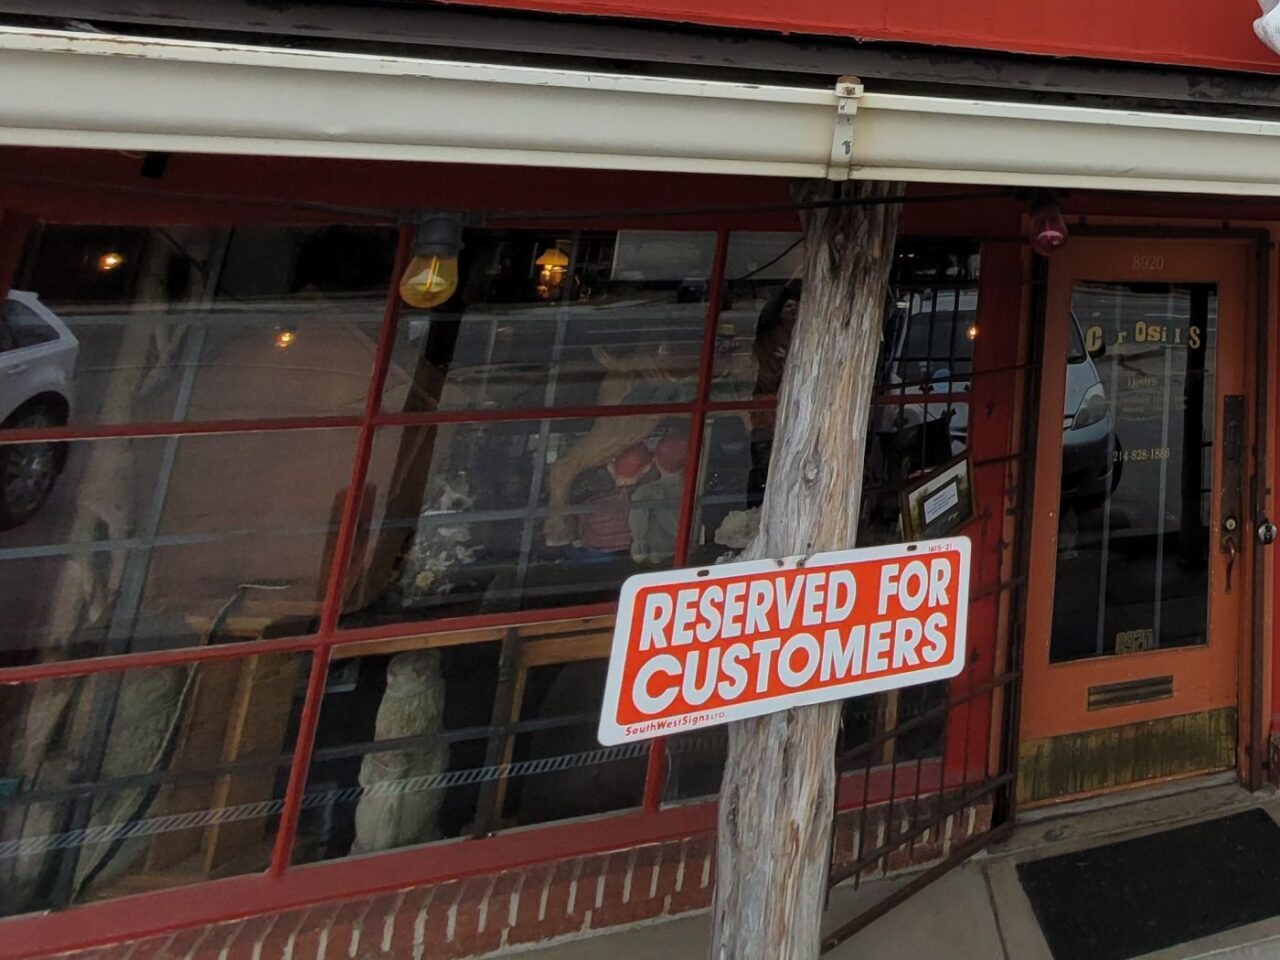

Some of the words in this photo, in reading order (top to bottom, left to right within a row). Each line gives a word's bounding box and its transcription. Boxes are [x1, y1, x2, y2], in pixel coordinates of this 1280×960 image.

[1132, 254, 1165, 271] 8920
[638, 569, 857, 651] RESERVED
[877, 557, 952, 615] FOR
[631, 612, 947, 715] CUSTOMERS
